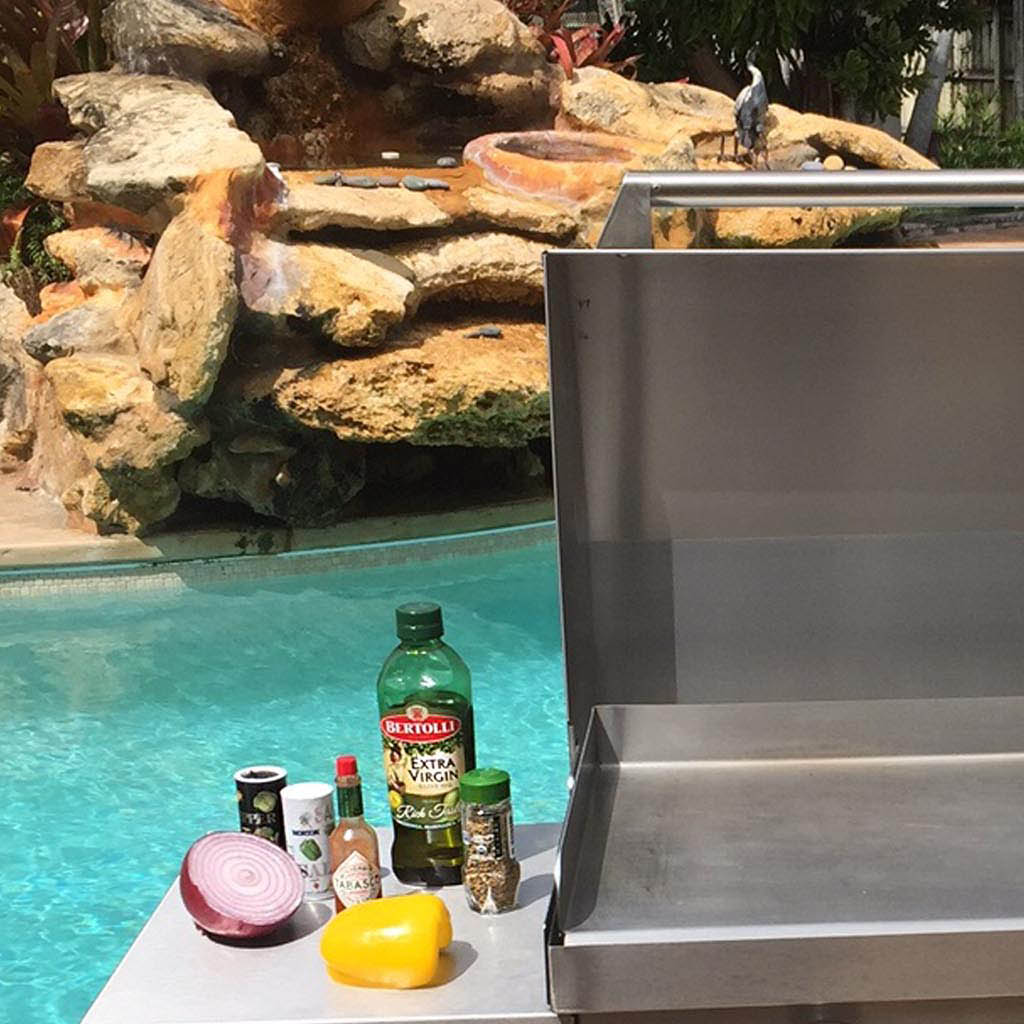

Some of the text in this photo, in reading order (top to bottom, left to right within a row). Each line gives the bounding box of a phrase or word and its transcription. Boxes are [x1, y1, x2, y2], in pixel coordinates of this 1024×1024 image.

[385, 720, 455, 735] BERTOLLI
[411, 756, 456, 770] EXTRA
[408, 769, 459, 783] VIRGIN
